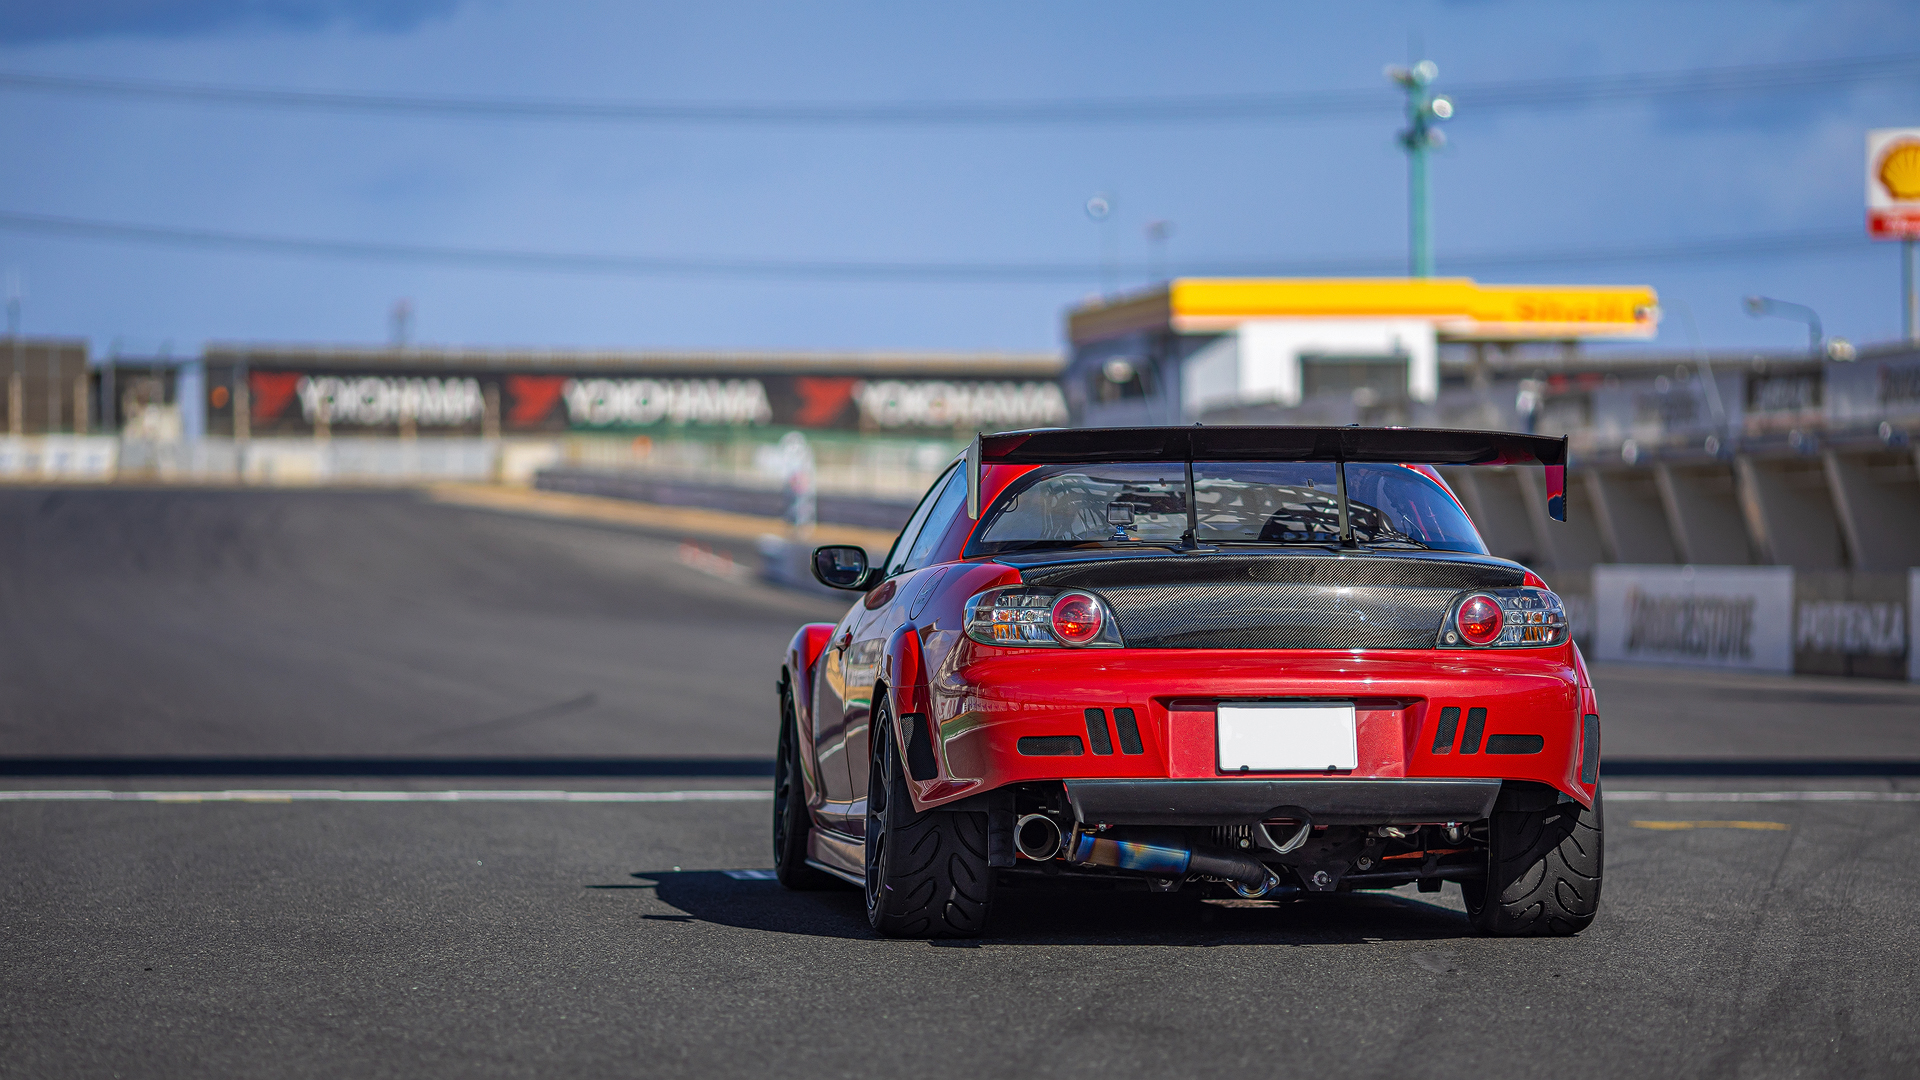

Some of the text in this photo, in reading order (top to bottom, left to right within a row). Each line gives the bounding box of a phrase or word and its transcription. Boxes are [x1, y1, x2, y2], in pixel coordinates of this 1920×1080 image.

[296, 375, 485, 425] YOKOHAMA
[561, 377, 773, 427] YOKOHAMA
[852, 379, 1069, 428] YOKOHAMA
